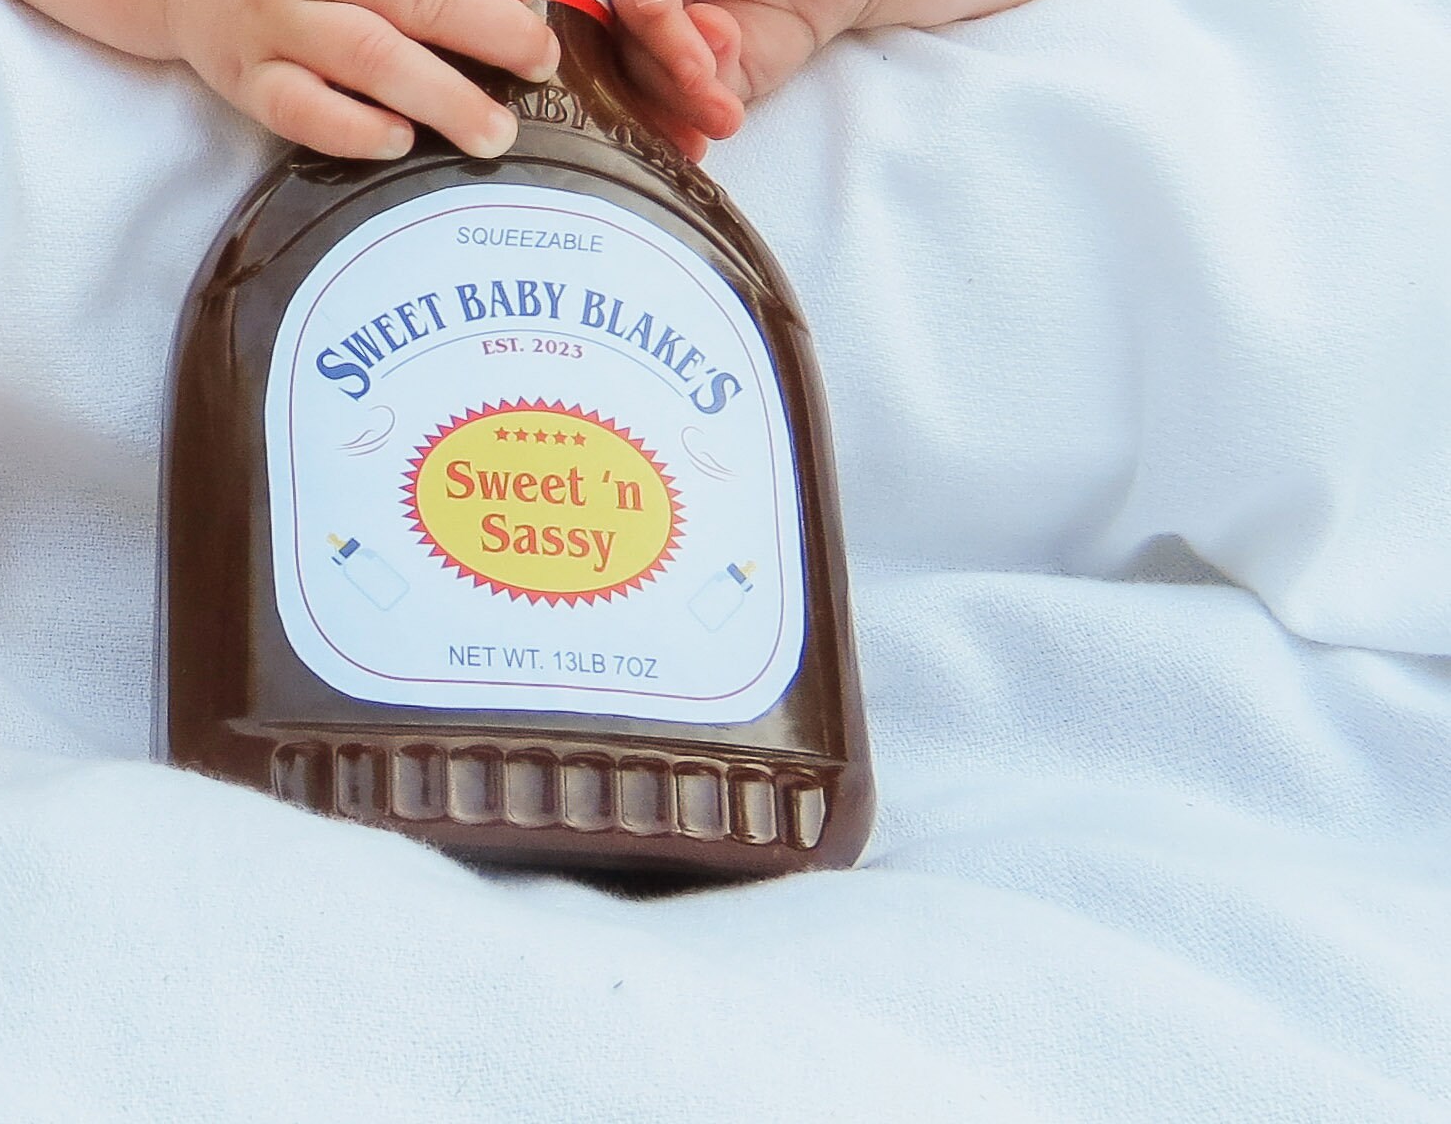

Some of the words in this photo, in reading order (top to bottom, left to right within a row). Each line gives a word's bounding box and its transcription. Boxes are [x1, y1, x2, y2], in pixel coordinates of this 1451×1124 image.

[456, 226, 604, 253] SQUEEZABLE
[315, 292, 448, 401] SWEET
[455, 279, 568, 323] BABY
[580, 288, 744, 415] BLAKE'S
[482, 339, 525, 356] EST.
[532, 337, 584, 360] 2023
[445, 459, 586, 507] Sweet
[601, 469, 644, 512] 'n
[480, 513, 617, 573] Sassy
[449, 645, 500, 668] NET
[502, 649, 545, 671] WT.
[553, 651, 606, 675] 13LB
[614, 654, 659, 680] 7OZ
